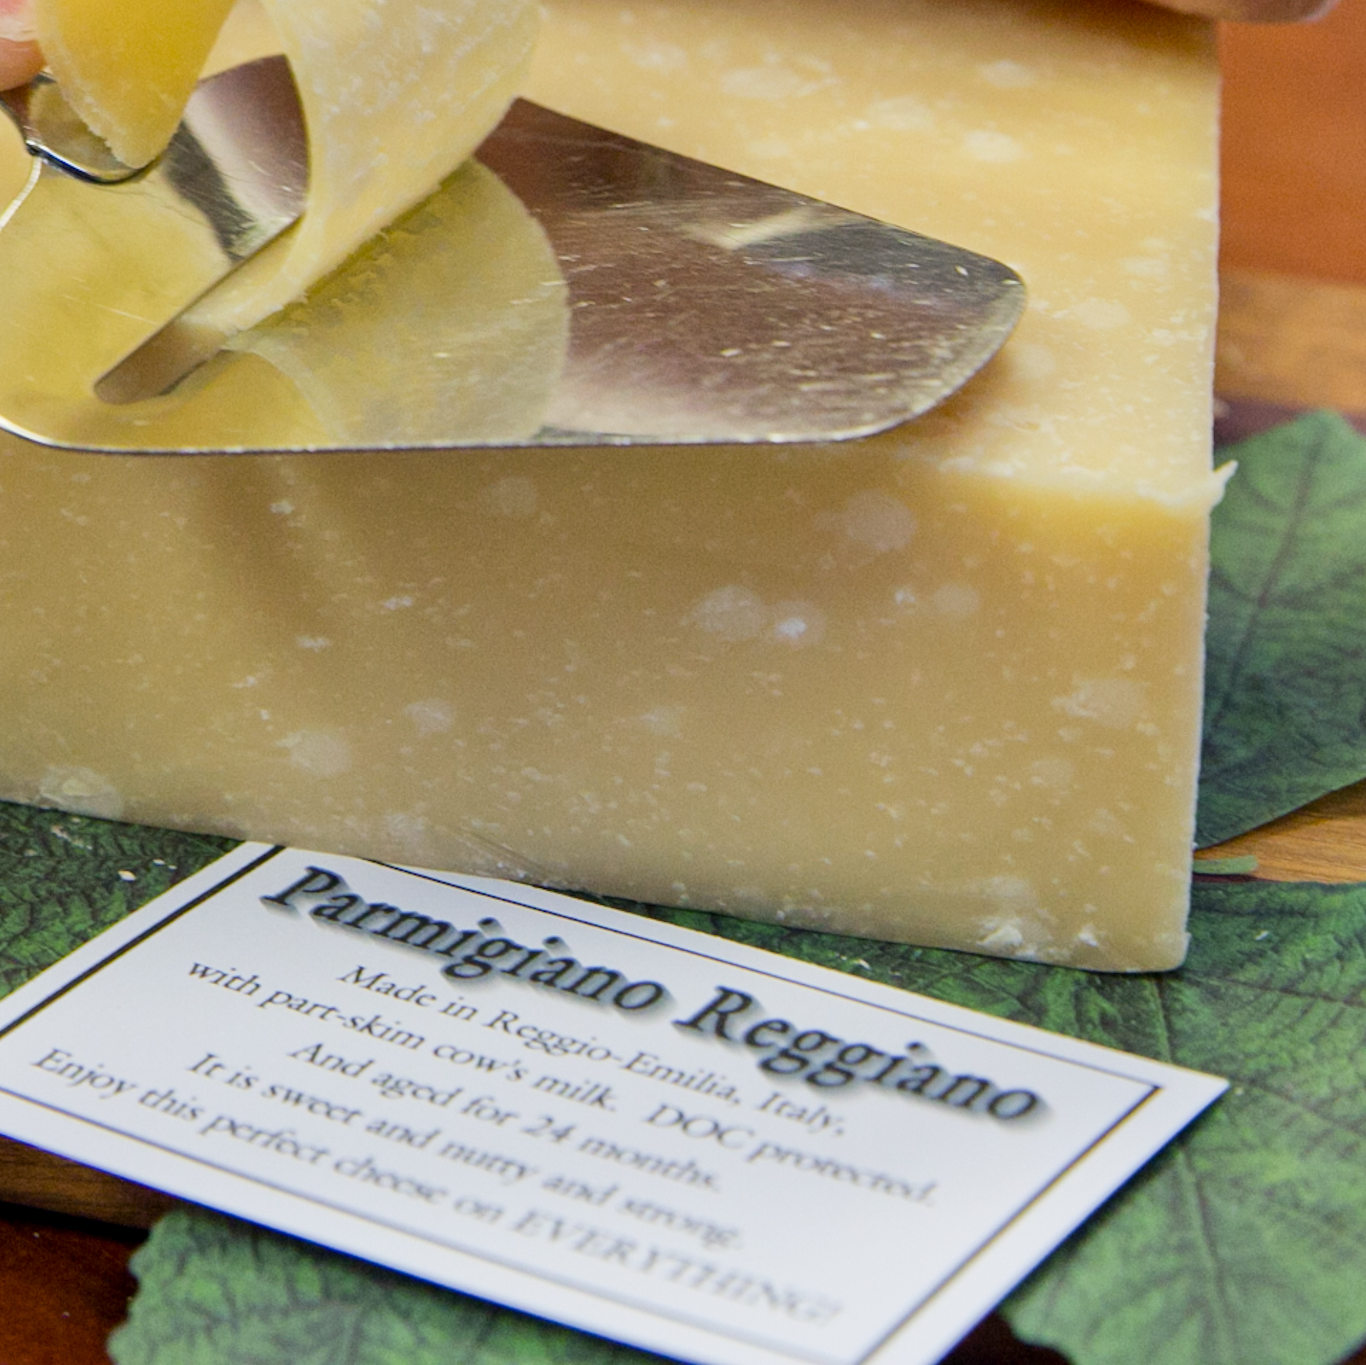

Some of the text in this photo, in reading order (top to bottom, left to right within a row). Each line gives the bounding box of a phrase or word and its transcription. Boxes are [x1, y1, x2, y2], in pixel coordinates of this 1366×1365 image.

[188, 962, 938, 1207] with part-skim cow's milk. DOC protected.
[260, 866, 1037, 1120] Parmigiano Reggiano
[338, 965, 845, 1136] Made in Reggio-Emilia, Italy,
[31, 1049, 137, 1099] Enjoy
[138, 1087, 205, 1122] this
[200, 1114, 332, 1165] perfect
[334, 1157, 449, 1205] cheese
[453, 1196, 504, 1224] on
[187, 1053, 743, 1252] It is sweet and nutty and strong.
[288, 1042, 721, 1192] And aged for 24 months.
